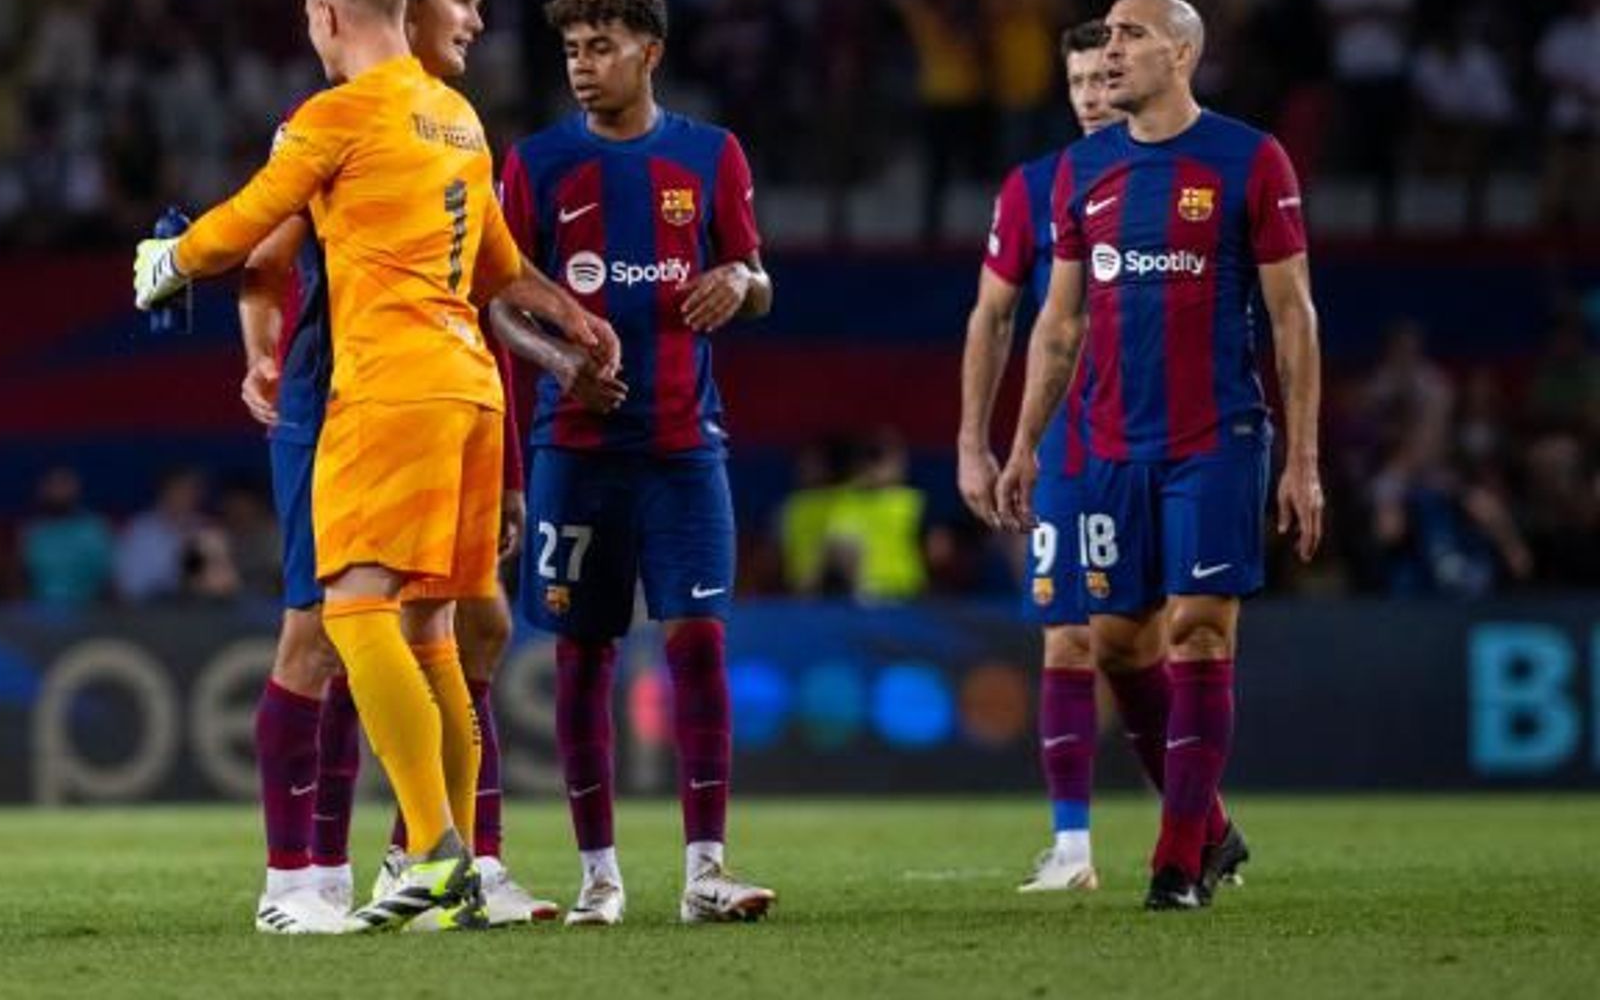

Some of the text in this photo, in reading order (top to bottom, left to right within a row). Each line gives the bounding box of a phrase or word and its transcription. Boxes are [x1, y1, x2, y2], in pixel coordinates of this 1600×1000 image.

[444, 179, 467, 295] 1
[1124, 248, 1206, 276] Spotify
[611, 257, 691, 291] Spotify
[538, 520, 593, 582] 27
[1078, 511, 1119, 568] 18
